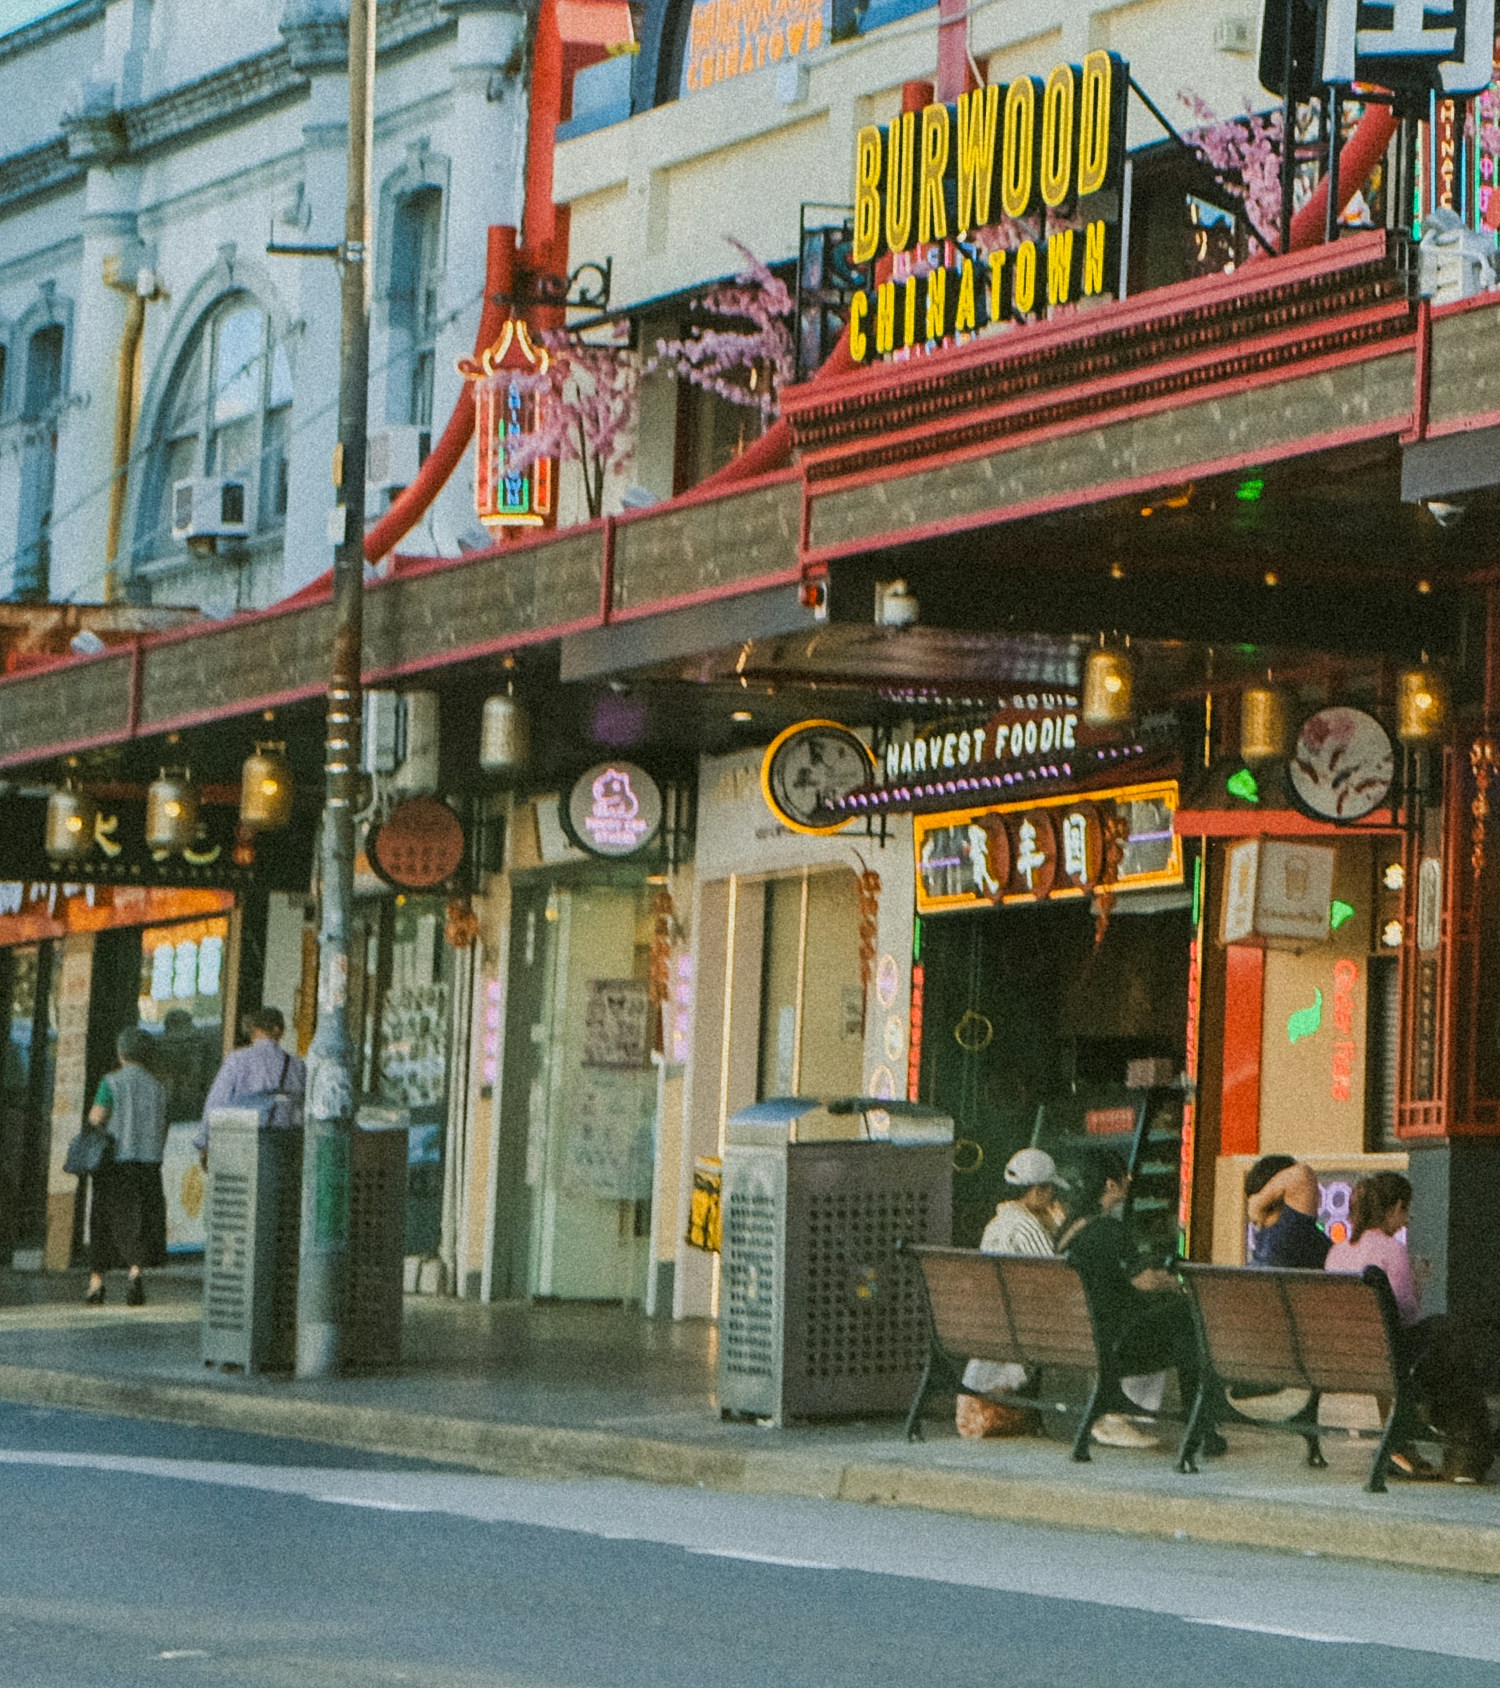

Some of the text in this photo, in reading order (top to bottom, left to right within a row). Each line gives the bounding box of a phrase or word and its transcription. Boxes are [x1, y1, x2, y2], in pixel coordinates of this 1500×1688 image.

[853, 49, 1112, 264] BURWOOD
[850, 220, 1106, 362] CHINATOWN
[886, 713, 1078, 776] HARVEST FOODIE
[1333, 957, 1359, 1034] Order
